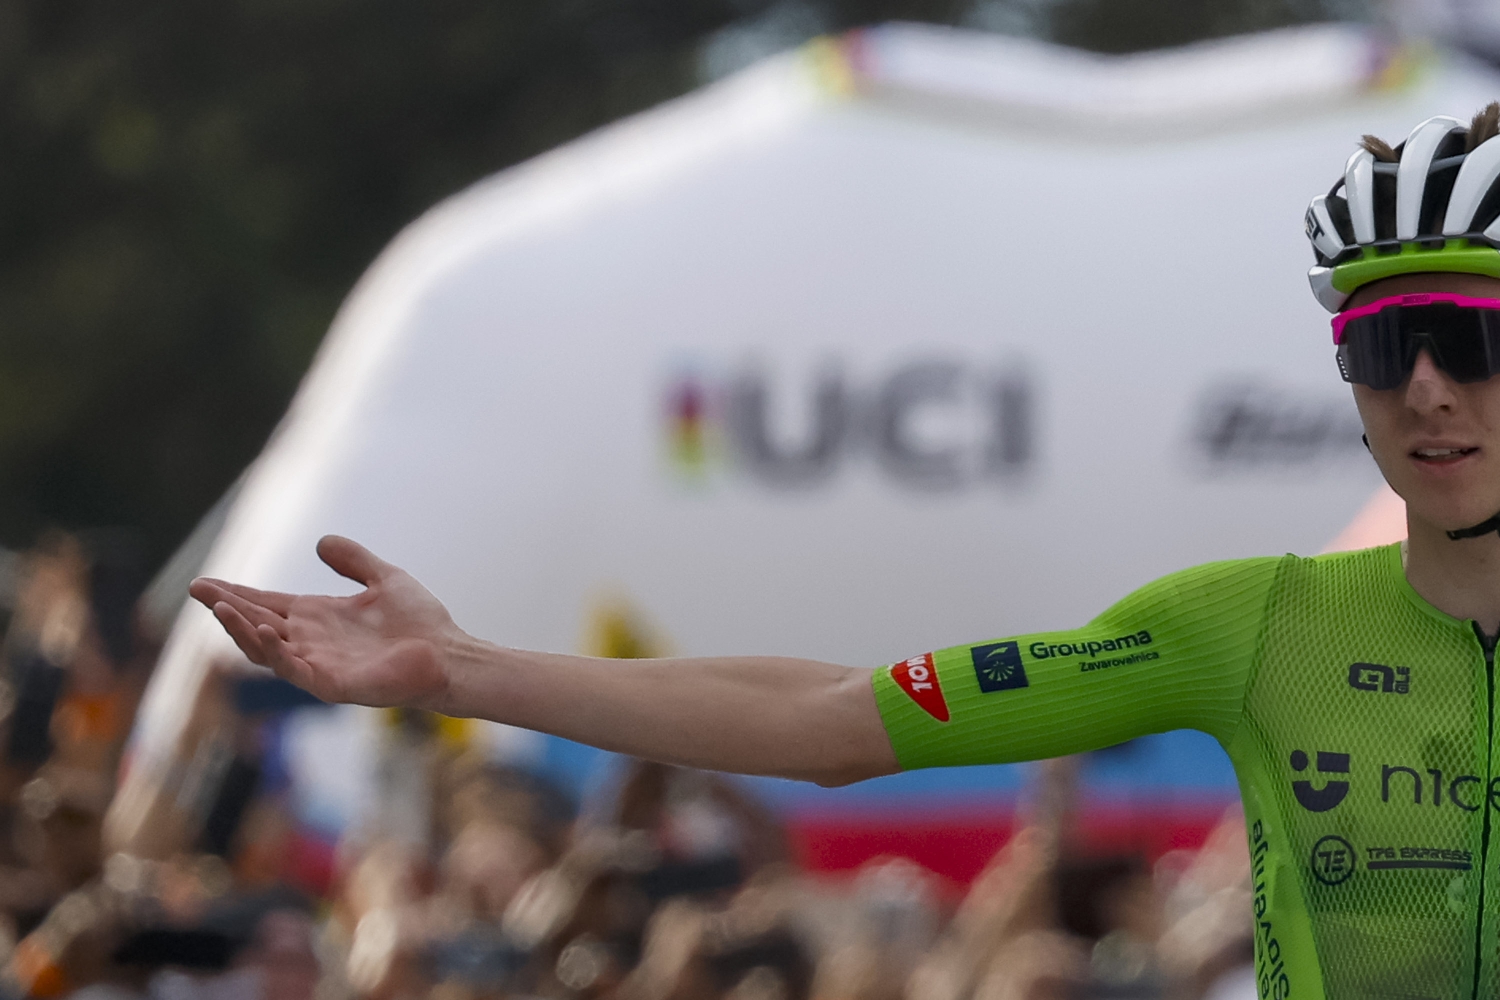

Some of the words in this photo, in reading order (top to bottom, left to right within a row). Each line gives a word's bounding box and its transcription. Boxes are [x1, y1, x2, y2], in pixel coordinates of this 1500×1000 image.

[731, 358, 1037, 492] UCI
[1029, 630, 1153, 659] Groupama
[1079, 651, 1160, 672] Zavarovalnica
[1400, 847, 1473, 861] EXPRESS
